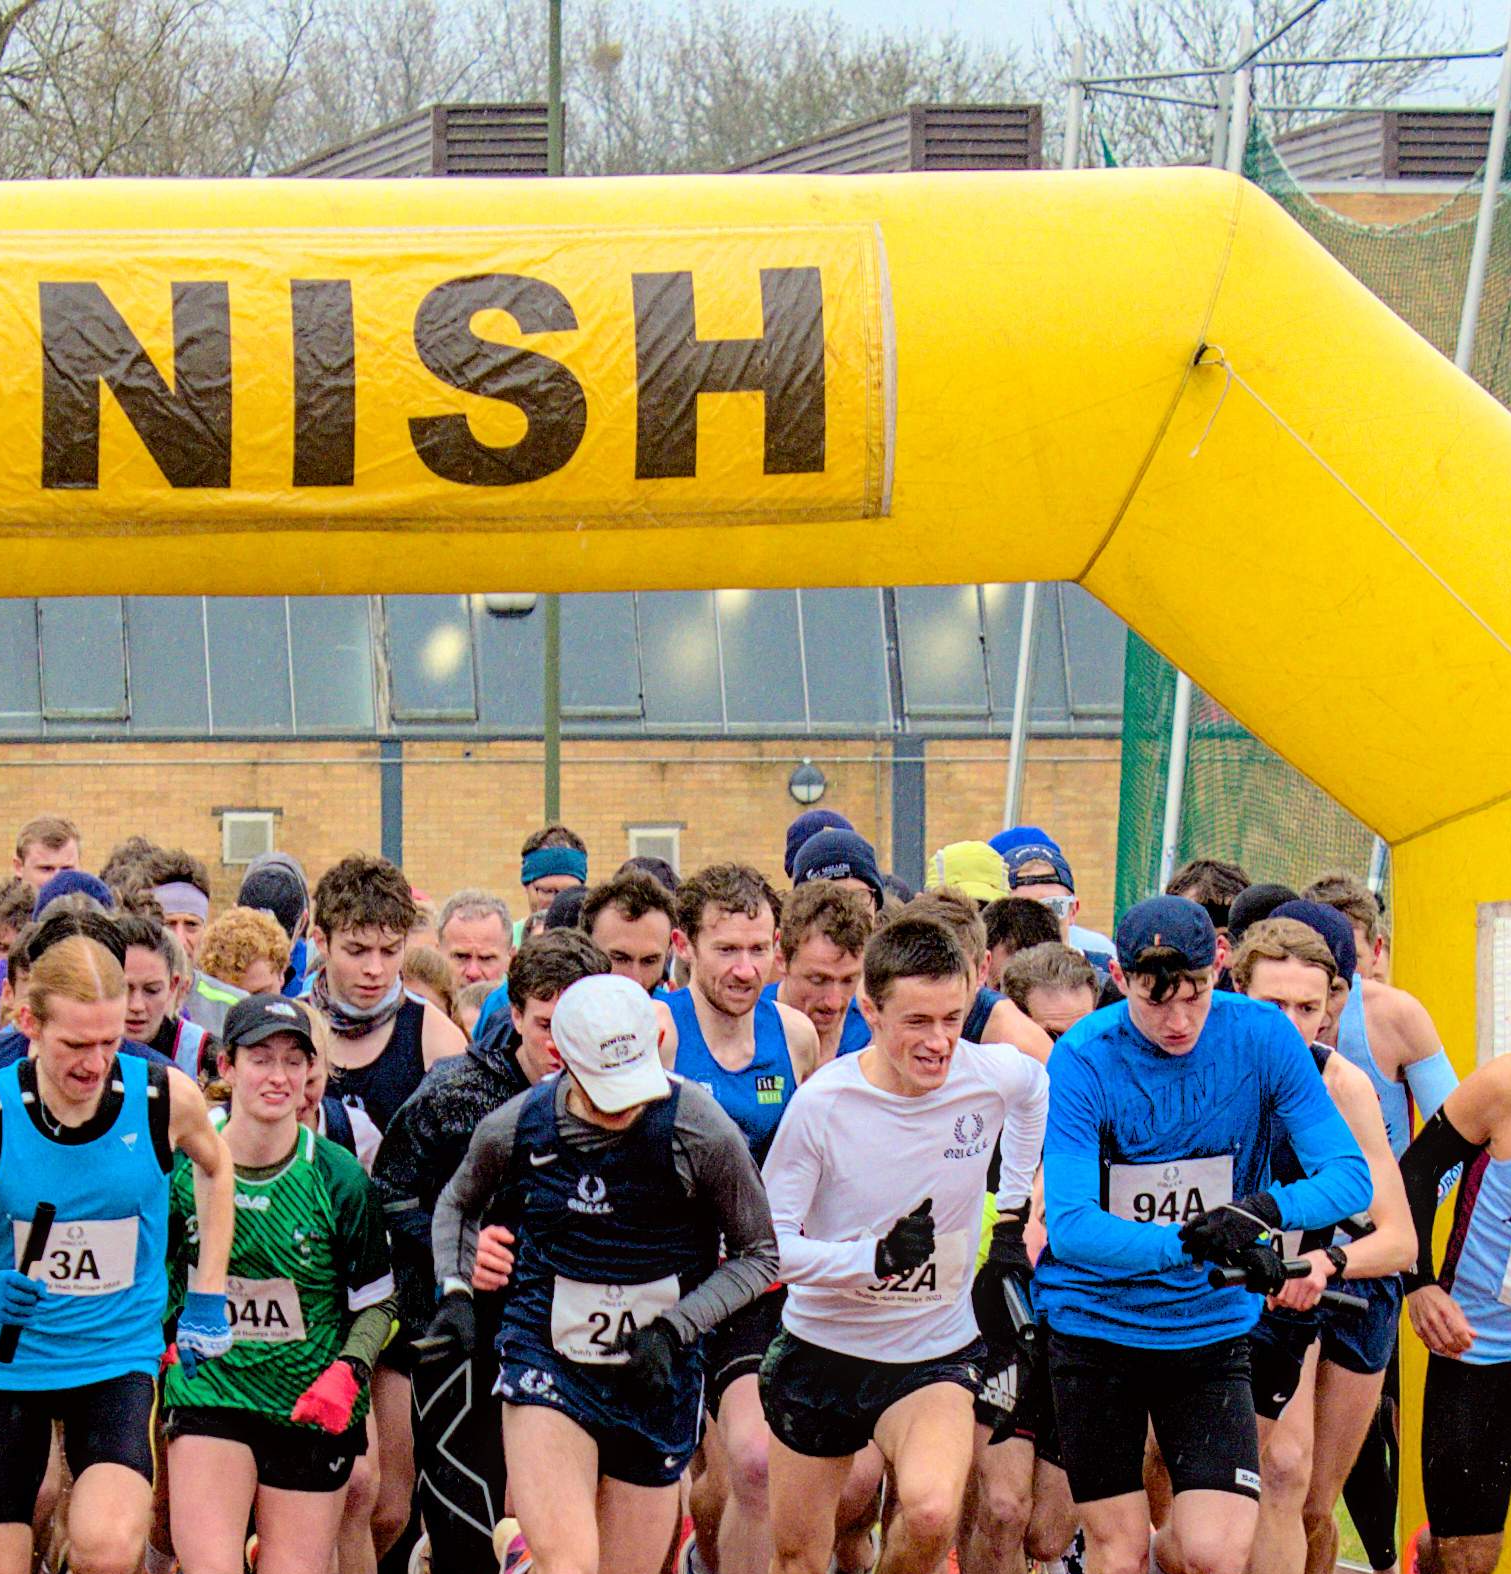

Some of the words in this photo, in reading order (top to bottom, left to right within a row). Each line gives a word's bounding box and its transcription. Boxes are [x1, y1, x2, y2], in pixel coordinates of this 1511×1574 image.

[1119, 1062, 1217, 1146] RUN
[1132, 1187, 1206, 1224] 94A
[49, 1248, 101, 1280] 3A
[588, 1309, 639, 1348] 2A
